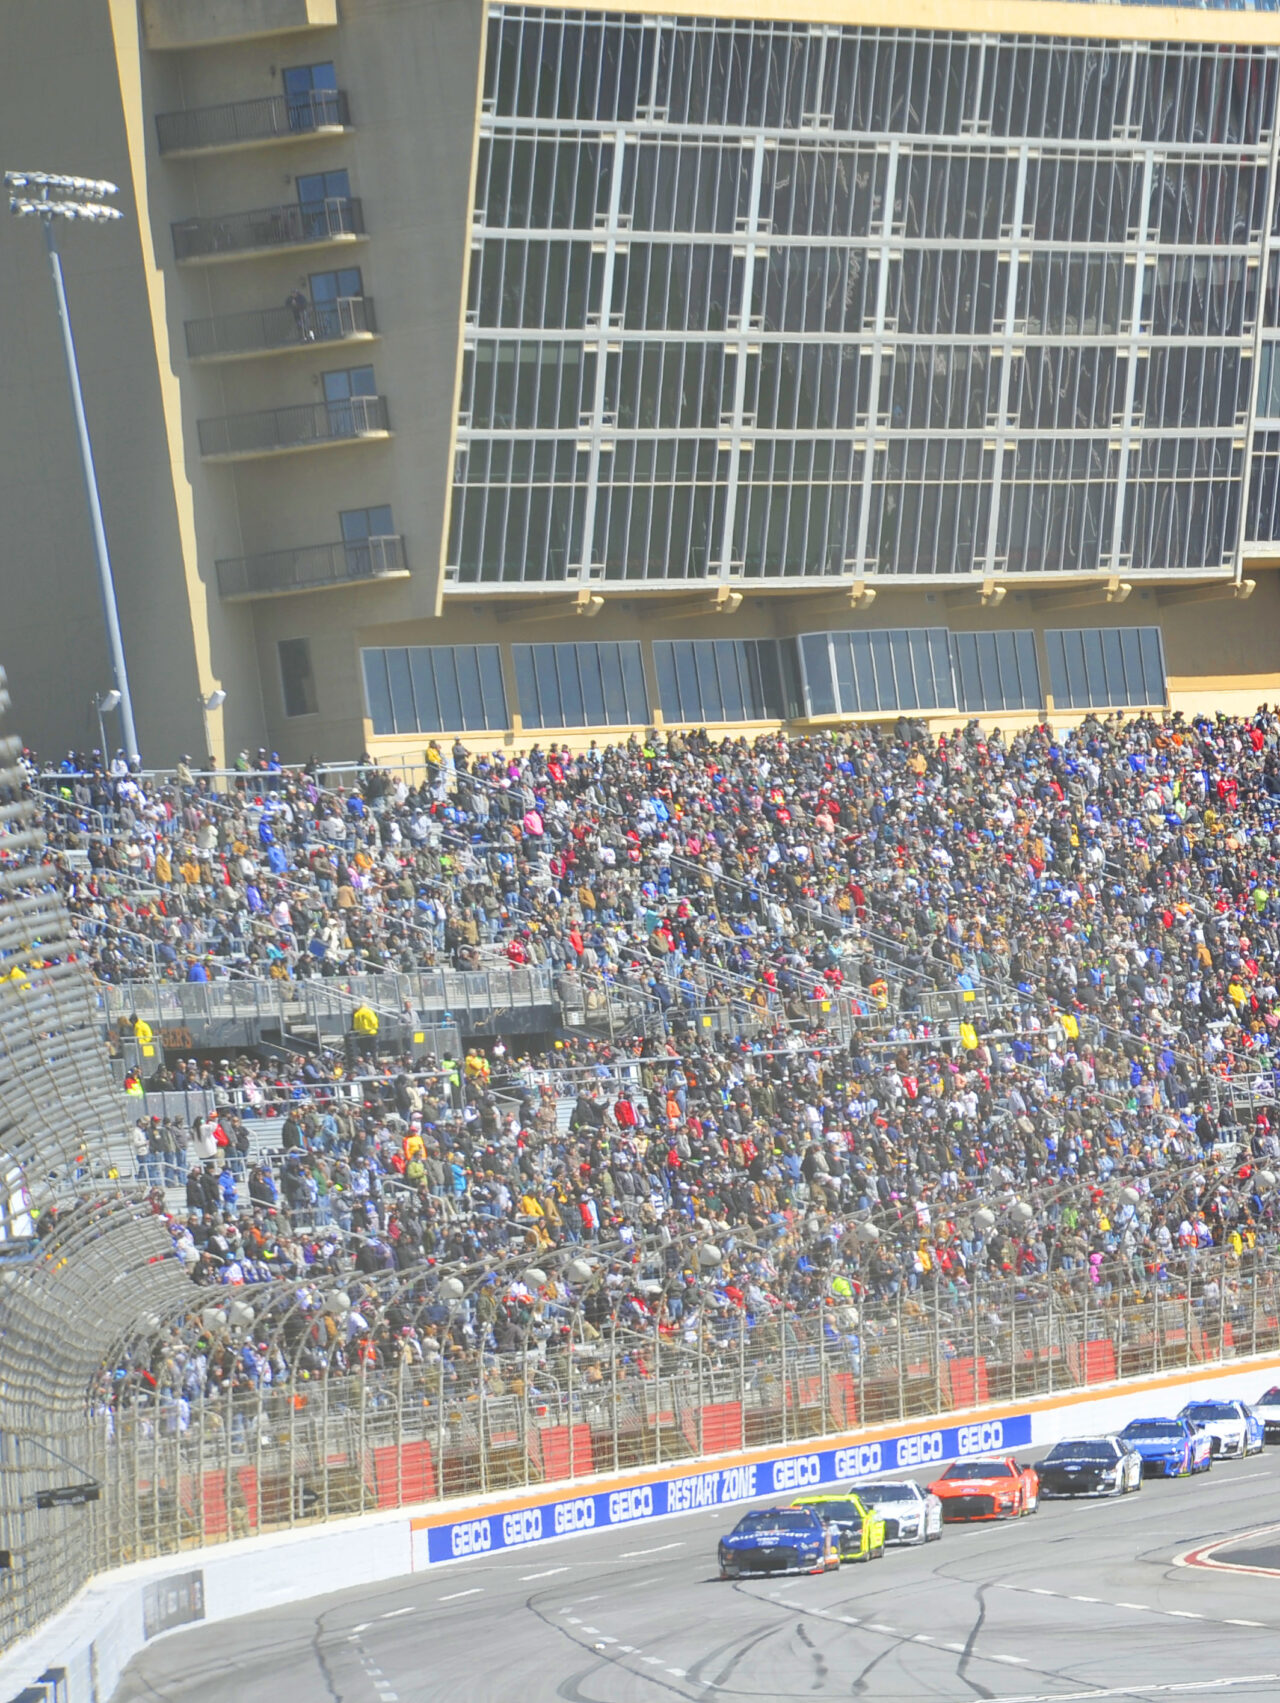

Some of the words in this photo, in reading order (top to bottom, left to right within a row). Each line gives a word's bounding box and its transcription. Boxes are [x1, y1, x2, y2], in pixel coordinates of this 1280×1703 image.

[451, 1519, 491, 1556] GEICO
[503, 1509, 542, 1545] GEICO
[554, 1497, 595, 1533] GEICO
[609, 1486, 653, 1522] GEICO
[667, 1472, 721, 1512] RESTART
[721, 1465, 757, 1500] ZONE
[773, 1454, 820, 1491] GEICO
[834, 1443, 882, 1478] GEICO
[896, 1432, 943, 1466] GEICO
[957, 1421, 1003, 1455] GEICO
